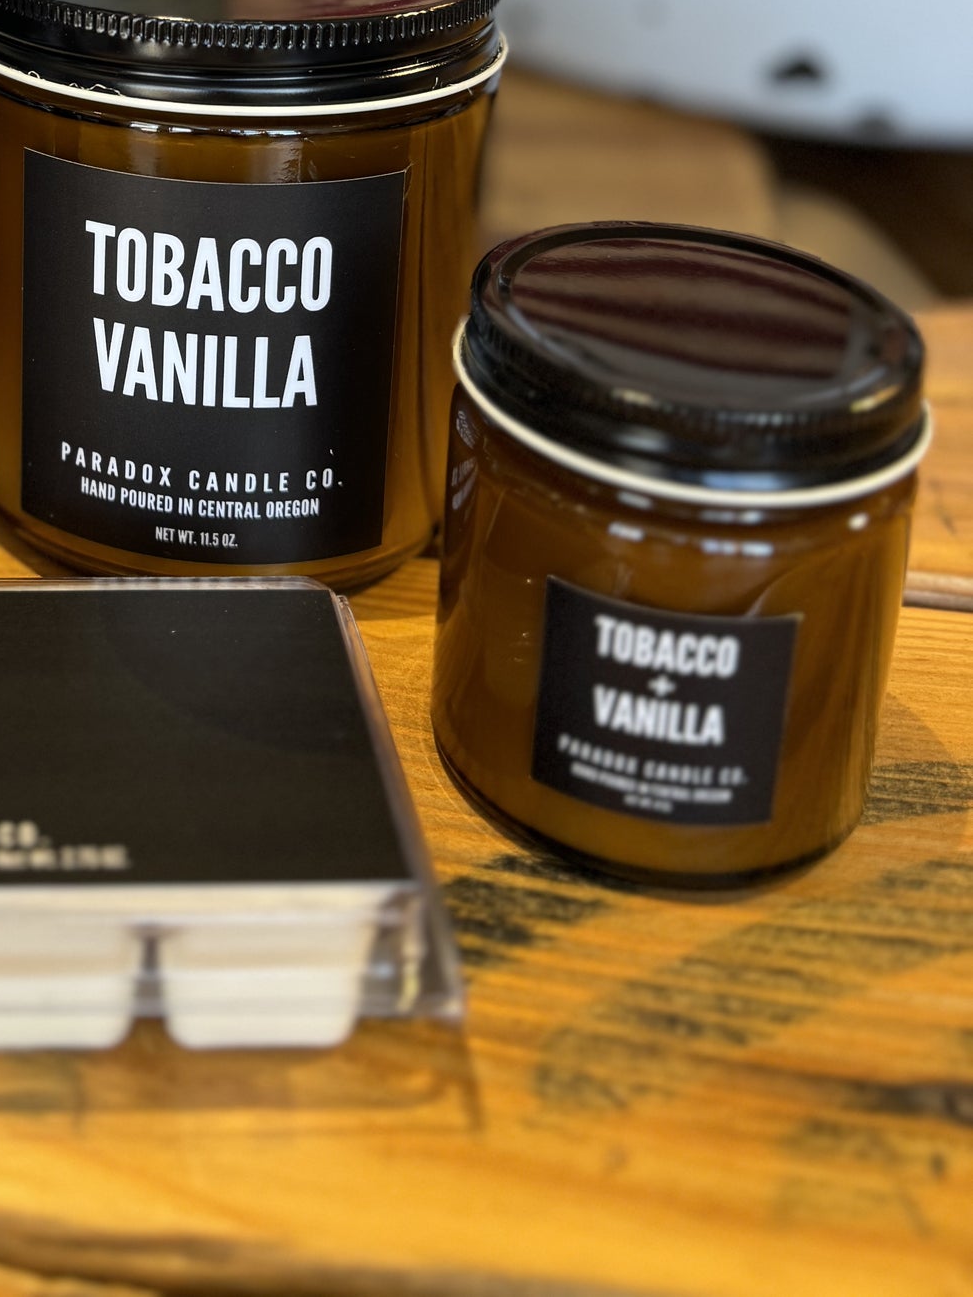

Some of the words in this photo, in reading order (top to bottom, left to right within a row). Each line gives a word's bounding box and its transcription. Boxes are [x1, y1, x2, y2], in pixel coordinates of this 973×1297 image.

[85, 219, 333, 314] TOBACCO
[93, 317, 318, 409] VANILLA
[60, 441, 172, 487] PARADOX
[188, 469, 290, 493] CANDLE
[306, 468, 344, 491] CO.
[80, 476, 116, 501] HAND
[120, 487, 173, 514] POURED
[178, 497, 193, 516] IN
[198, 499, 261, 519] CENTRAL
[266, 497, 320, 518] OREGON
[155, 526, 175, 543] NET
[178, 529, 197, 546] WT.
[200, 532, 220, 547] 11.5
[222, 533, 238, 548] OZ.
[594, 614, 740, 679] TOBACCO
[593, 683, 724, 746] VANILLA
